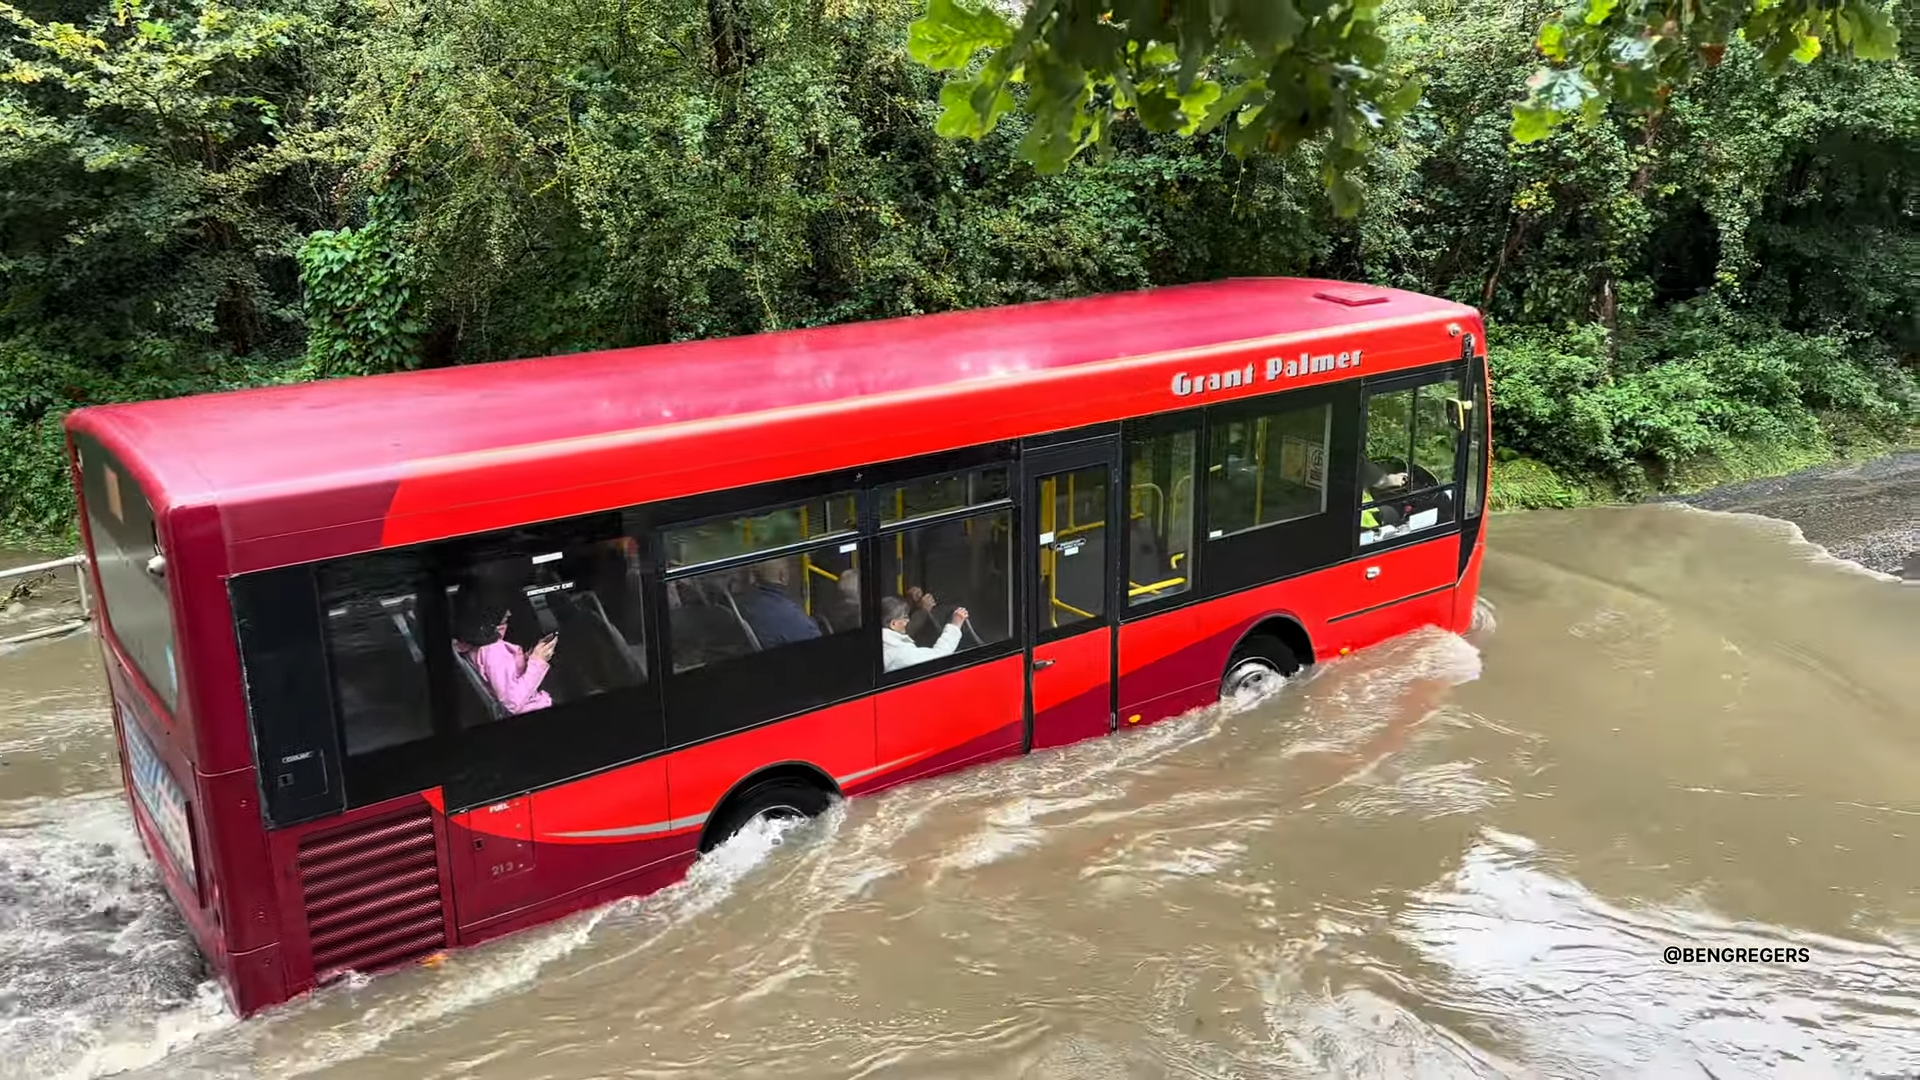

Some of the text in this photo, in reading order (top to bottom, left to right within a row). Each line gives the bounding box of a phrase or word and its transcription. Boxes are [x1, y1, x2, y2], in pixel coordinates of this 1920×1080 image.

[1171, 350, 1363, 396] Grant Palmer
[489, 802, 510, 813] FUEL
[491, 862, 514, 876] 213
